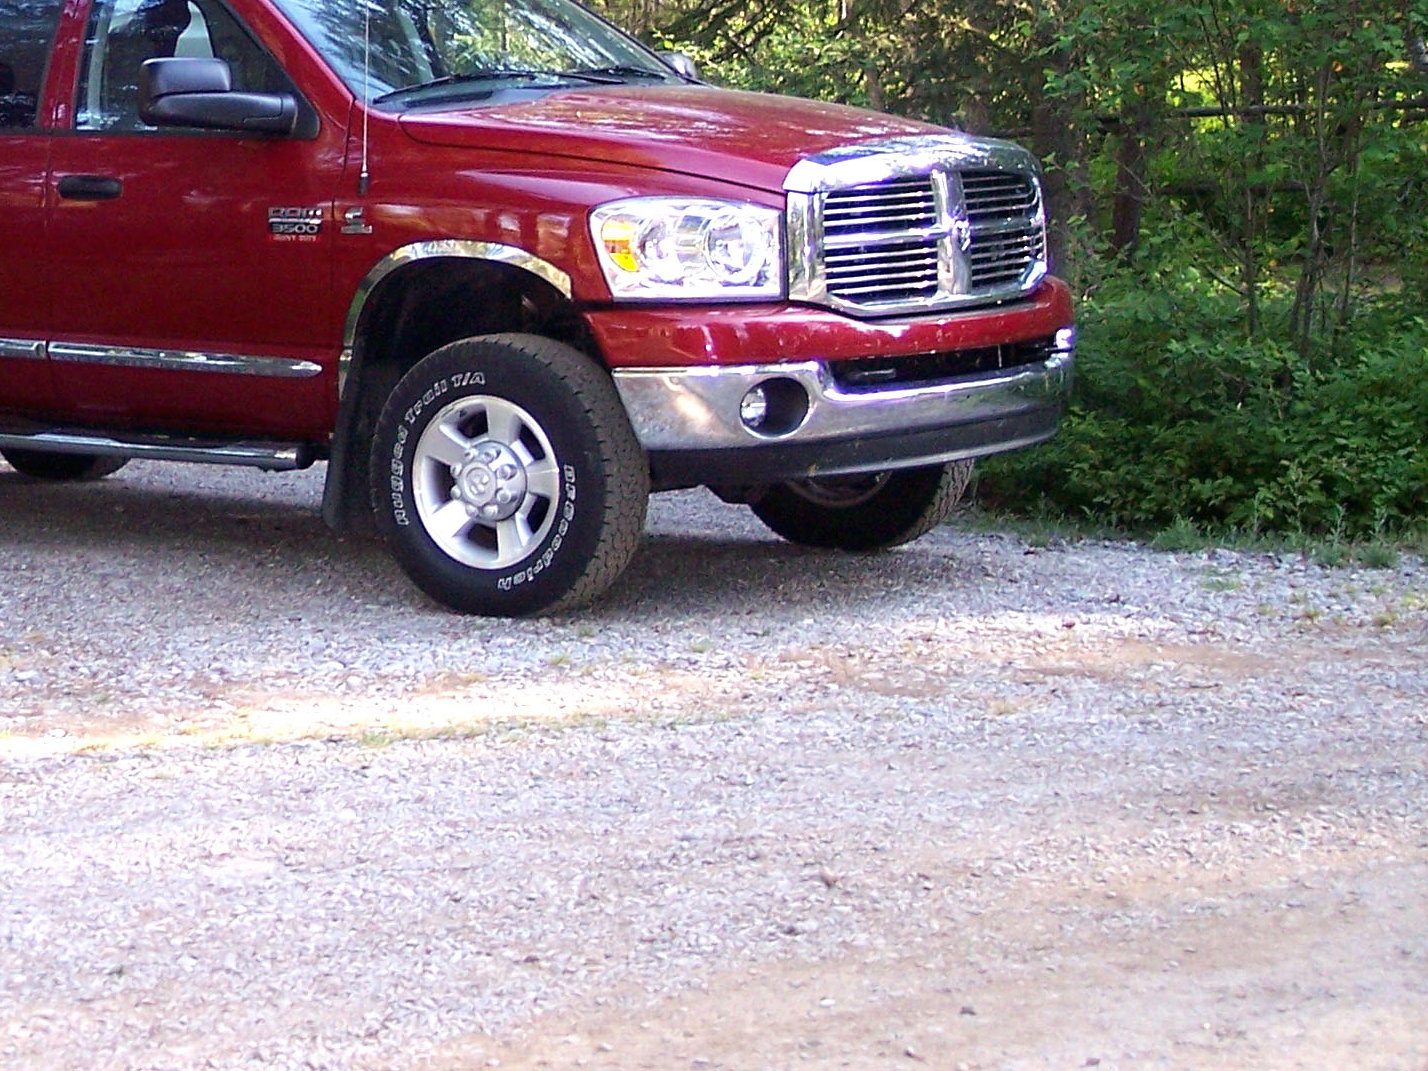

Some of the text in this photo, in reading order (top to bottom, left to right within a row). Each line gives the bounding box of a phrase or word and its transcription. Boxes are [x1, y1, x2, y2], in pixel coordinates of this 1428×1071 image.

[272, 224, 318, 233] 3500
[404, 382, 448, 424] Trail
[451, 371, 486, 386] T/A
[497, 464, 576, 590] BFGoodrich
